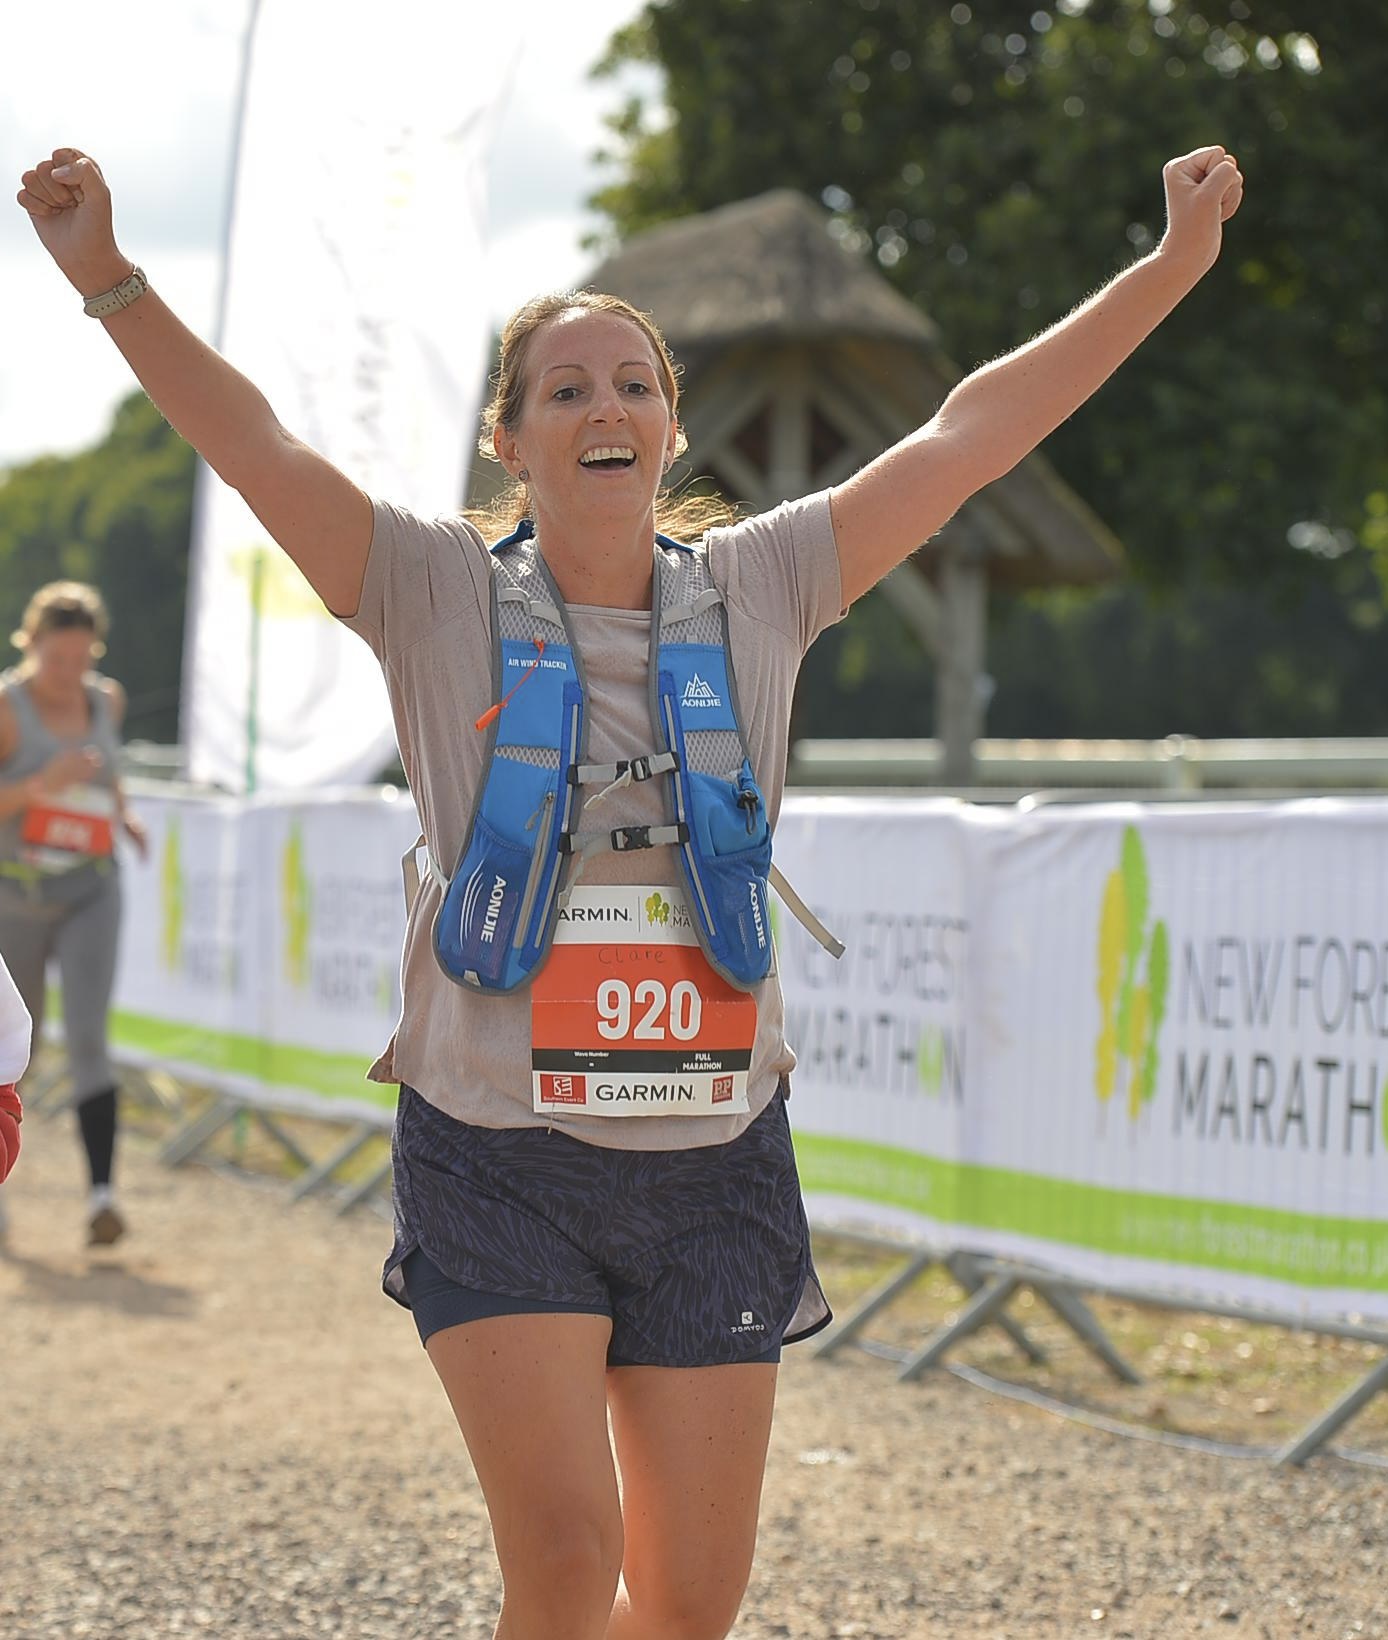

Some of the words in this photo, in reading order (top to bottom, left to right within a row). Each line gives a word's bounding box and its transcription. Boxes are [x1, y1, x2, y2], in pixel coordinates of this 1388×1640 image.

[508, 657, 520, 667] AIR
[540, 660, 567, 670] TRACKER
[681, 698, 721, 708] AONIJIE
[481, 874, 507, 944] AONIJIE
[748, 881, 767, 950] AONIJIE
[596, 979, 701, 1041] 920
[1178, 935, 1284, 1032] NEW
[682, 1062, 722, 1071] MARATHON
[695, 1053, 712, 1061] FULL
[1171, 1046, 1388, 1158] MARATH
